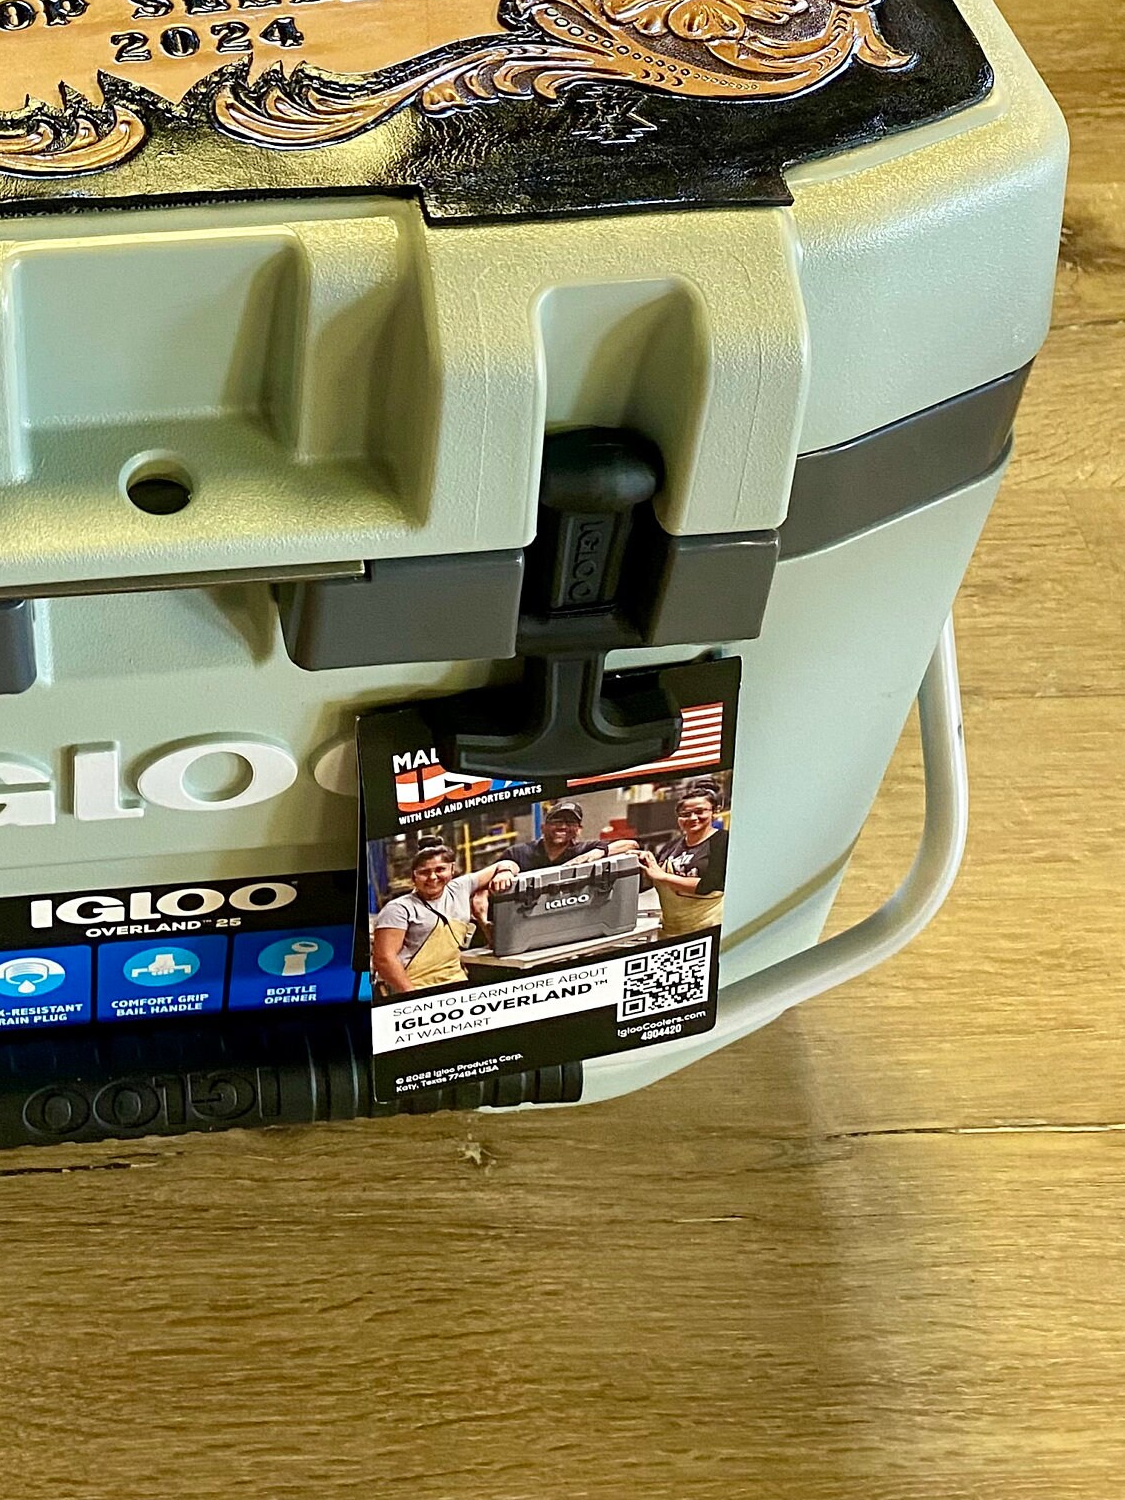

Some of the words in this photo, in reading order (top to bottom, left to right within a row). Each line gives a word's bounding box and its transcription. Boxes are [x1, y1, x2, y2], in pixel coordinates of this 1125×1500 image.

[110, 16, 304, 62] 2024
[569, 520, 605, 600] IGLOO
[399, 812, 422, 825] WITH
[424, 807, 442, 819] USA
[444, 802, 463, 815] AND
[465, 790, 511, 808] IMPORTED
[513, 785, 542, 798] PARTS
[30, 882, 298, 928] IGLOO
[545, 893, 590, 910] IGLOO
[215, 917, 241, 928] 25
[111, 996, 173, 1009] COMFORT
[177, 993, 209, 1004] GRIP
[264, 993, 317, 1005] OPENER
[266, 985, 317, 996] BOTTLE
[393, 1002, 434, 1017] SCAN
[436, 997, 457, 1008] TO
[460, 987, 509, 1003] LEARN
[512, 978, 554, 993] MORE
[558, 967, 608, 984] ABOUT
[33, 1012, 68, 1024] PLUG
[116, 1004, 147, 1017] BAIL
[150, 1002, 203, 1014] HANDLE
[395, 1008, 464, 1032] IGLOO
[395, 1033, 414, 1044] AT
[416, 1017, 492, 1039] WALMART
[617, 1010, 707, 1037] IglooCoolers.com
[641, 1024, 682, 1040] 4904420
[433, 1066, 455, 1078] Igloo
[457, 1058, 498, 1071] Products
[499, 1052, 523, 1064] Corp.
[396, 1082, 419, 1093] Katy,
[421, 1077, 447, 1087] Texas
[478, 1065, 499, 1074] USA
[22, 1067, 281, 1135] IGLOO
